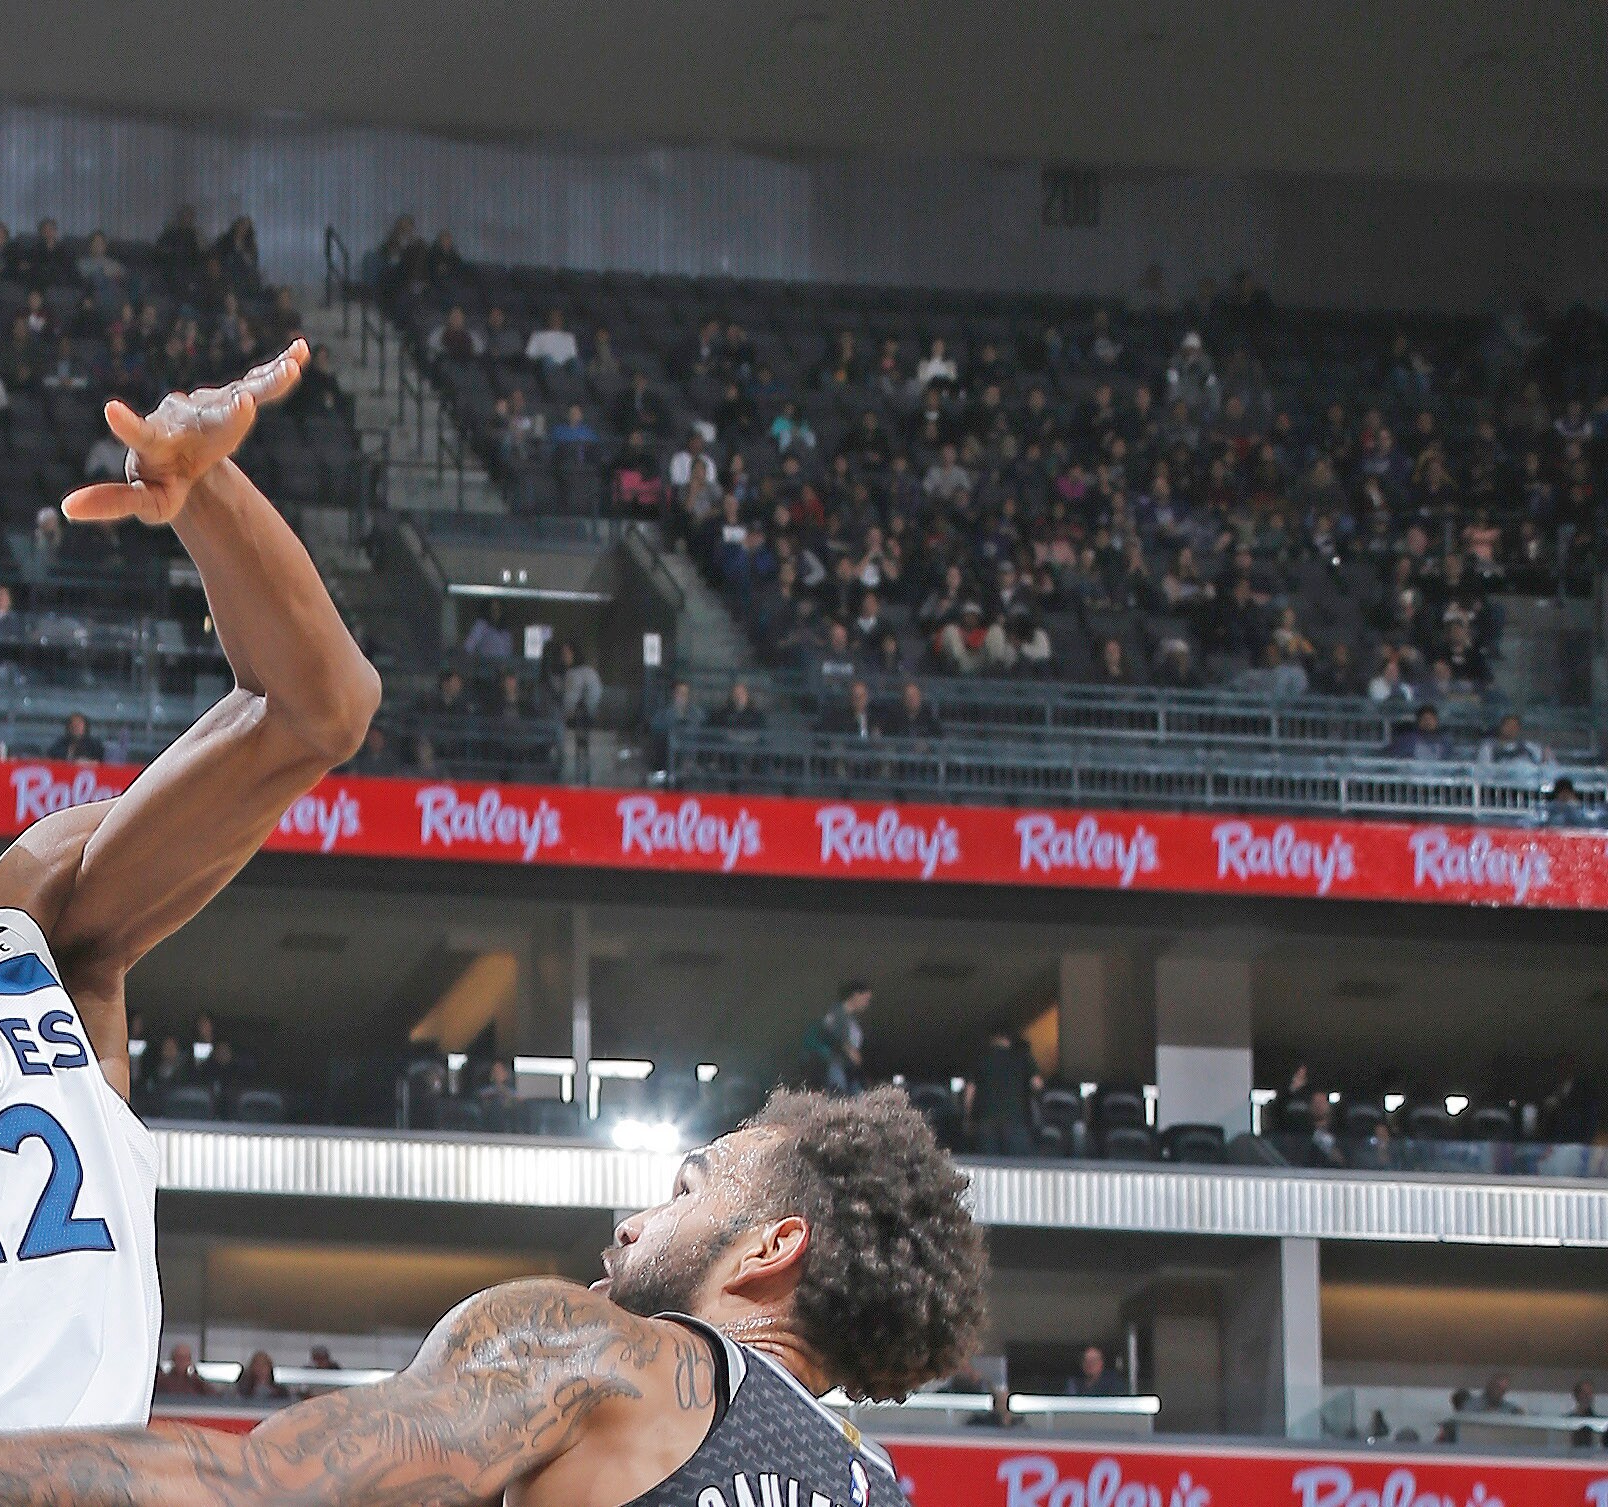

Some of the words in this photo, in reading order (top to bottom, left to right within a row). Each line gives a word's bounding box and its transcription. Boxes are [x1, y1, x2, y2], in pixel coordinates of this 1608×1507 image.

[415, 785, 561, 862] Raley's
[616, 795, 761, 872] Raley's
[815, 805, 960, 880] Raley's
[1014, 814, 1158, 888] Raley's
[1211, 821, 1355, 896] Raley's
[1409, 829, 1551, 904] Raley's
